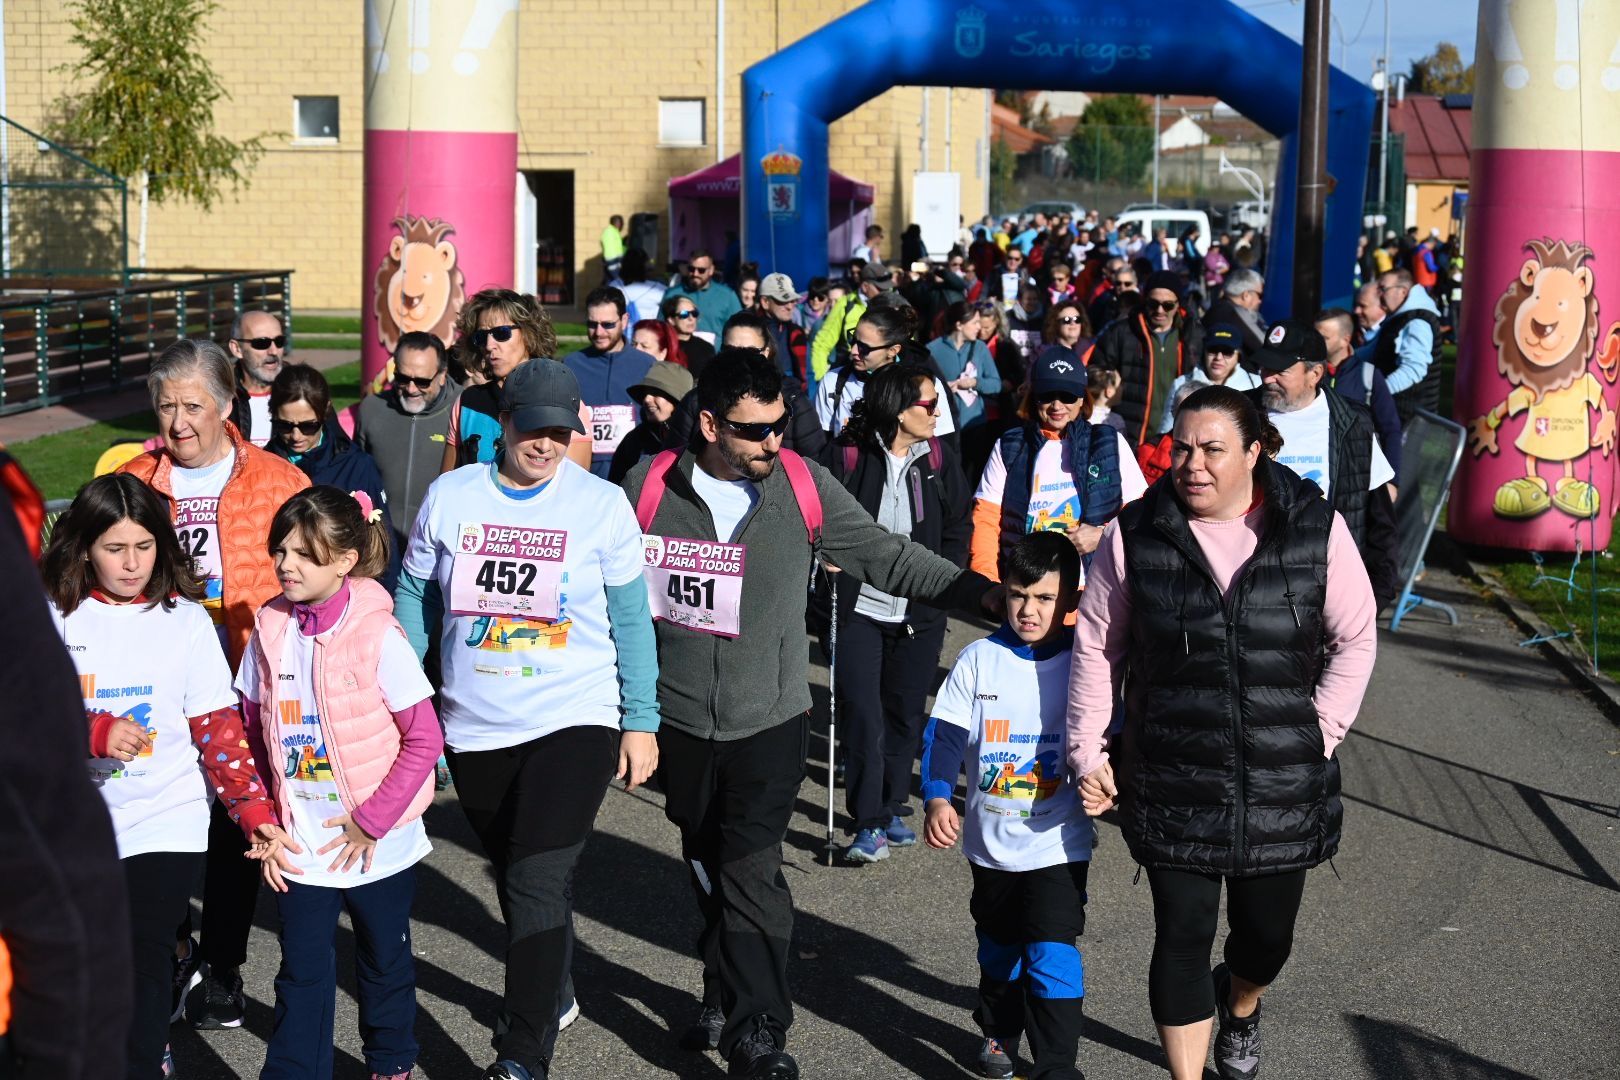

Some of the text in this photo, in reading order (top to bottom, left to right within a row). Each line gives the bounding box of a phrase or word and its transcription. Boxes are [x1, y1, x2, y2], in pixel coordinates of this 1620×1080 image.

[1010, 30, 1152, 73] Sariegos
[486, 527, 565, 547] DEPORTE
[485, 543, 562, 559] PARA TODOS
[666, 540, 743, 561] DEPORTE
[665, 556, 741, 573] PARA TODOS
[475, 560, 538, 597] 452
[667, 574, 716, 610] 451
[96, 688, 120, 699] CROSS
[121, 685, 153, 697] POPULAR
[279, 700, 301, 724] VII
[984, 719, 1060, 744] VII CROSS POPULAR
